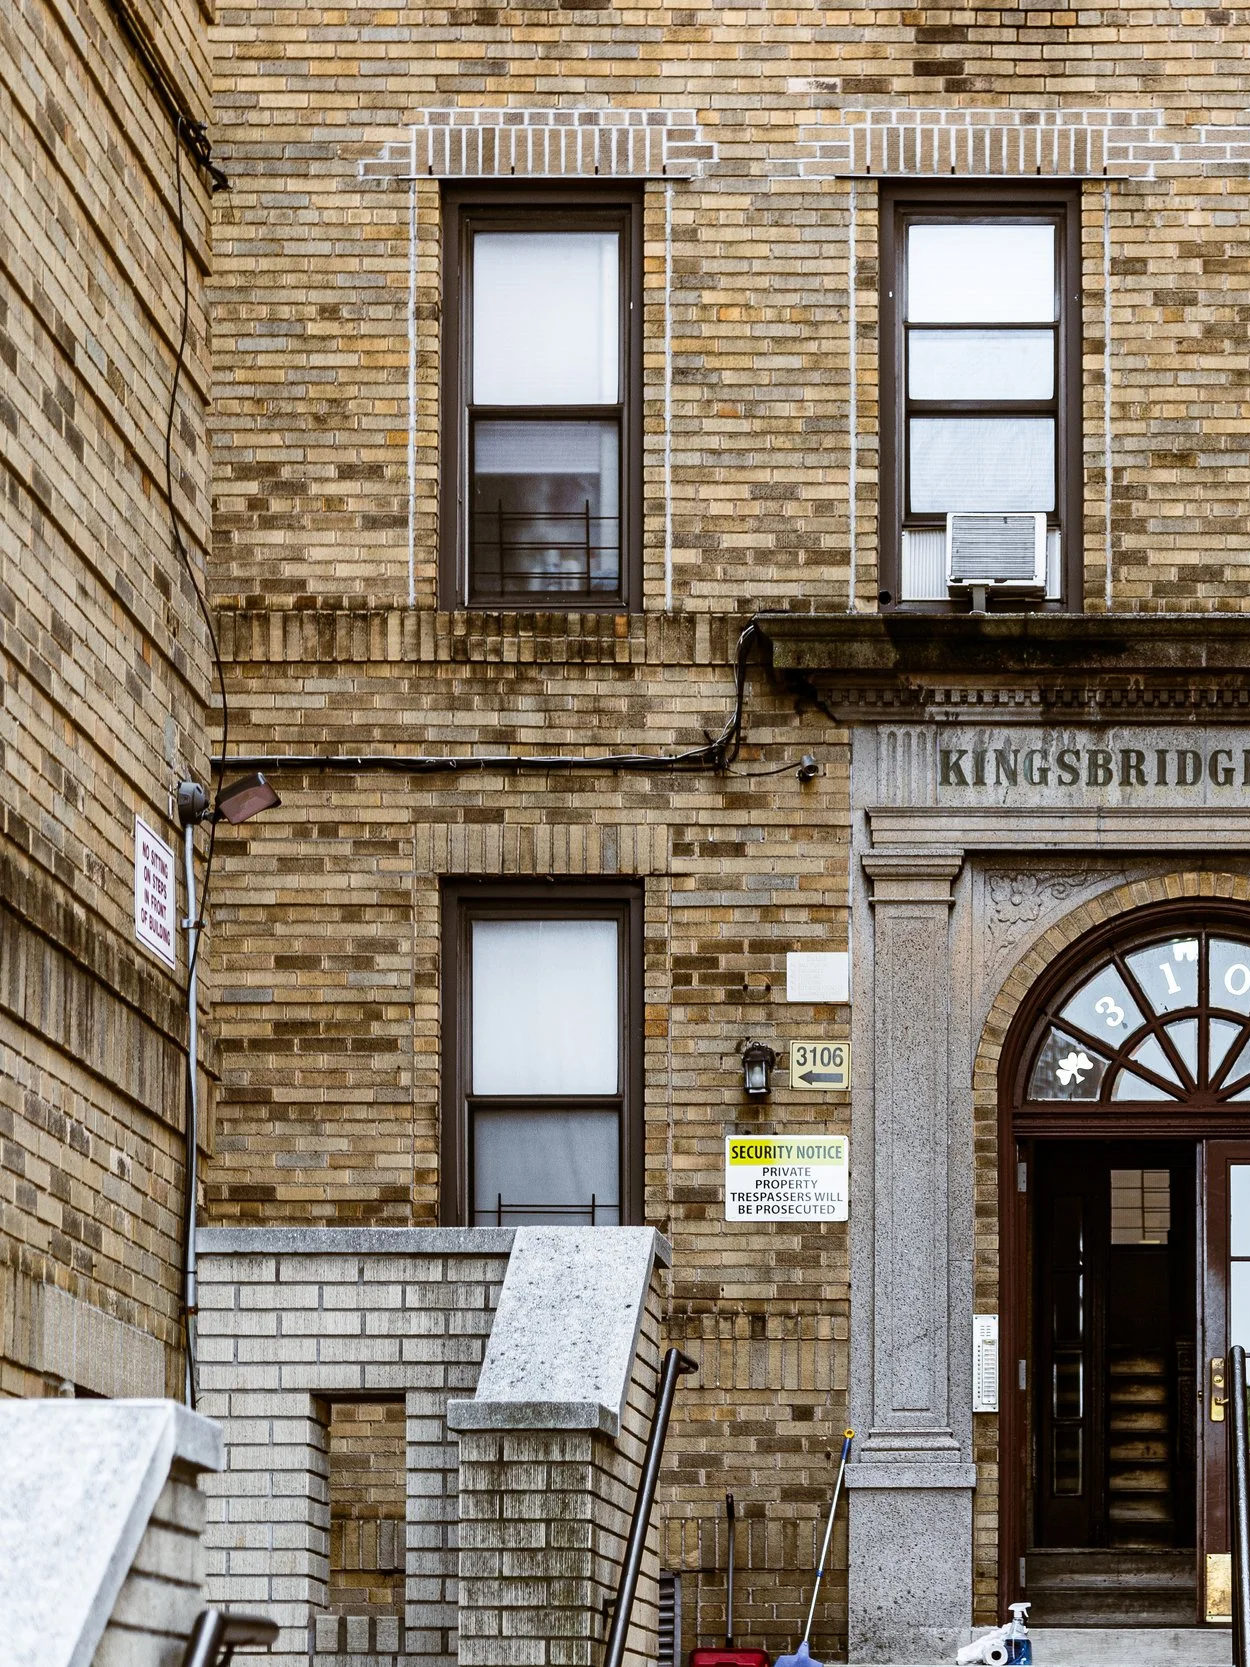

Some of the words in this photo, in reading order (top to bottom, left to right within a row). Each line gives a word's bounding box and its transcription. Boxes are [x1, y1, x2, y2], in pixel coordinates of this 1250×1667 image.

[142, 841, 150, 861] NO
[150, 849, 169, 880] SITTING
[143, 865, 151, 885] ON
[152, 873, 168, 900] STEPS
[144, 890, 150, 906] IN
[151, 894, 167, 921] FRONT
[140, 907, 148, 926] OF
[149, 914, 171, 947] BUILDING
[796, 1046, 844, 1067] 3106
[731, 1145, 793, 1160] SECURITY
[796, 1145, 842, 1160] NOTICE
[762, 1166, 811, 1177] PRIVATE
[755, 1179, 818, 1190] PROPERTY
[730, 1192, 811, 1202] TRESPASSERS
[814, 1192, 843, 1202] WILL
[738, 1205, 753, 1215] BE
[756, 1205, 836, 1215] PROSECUTED
